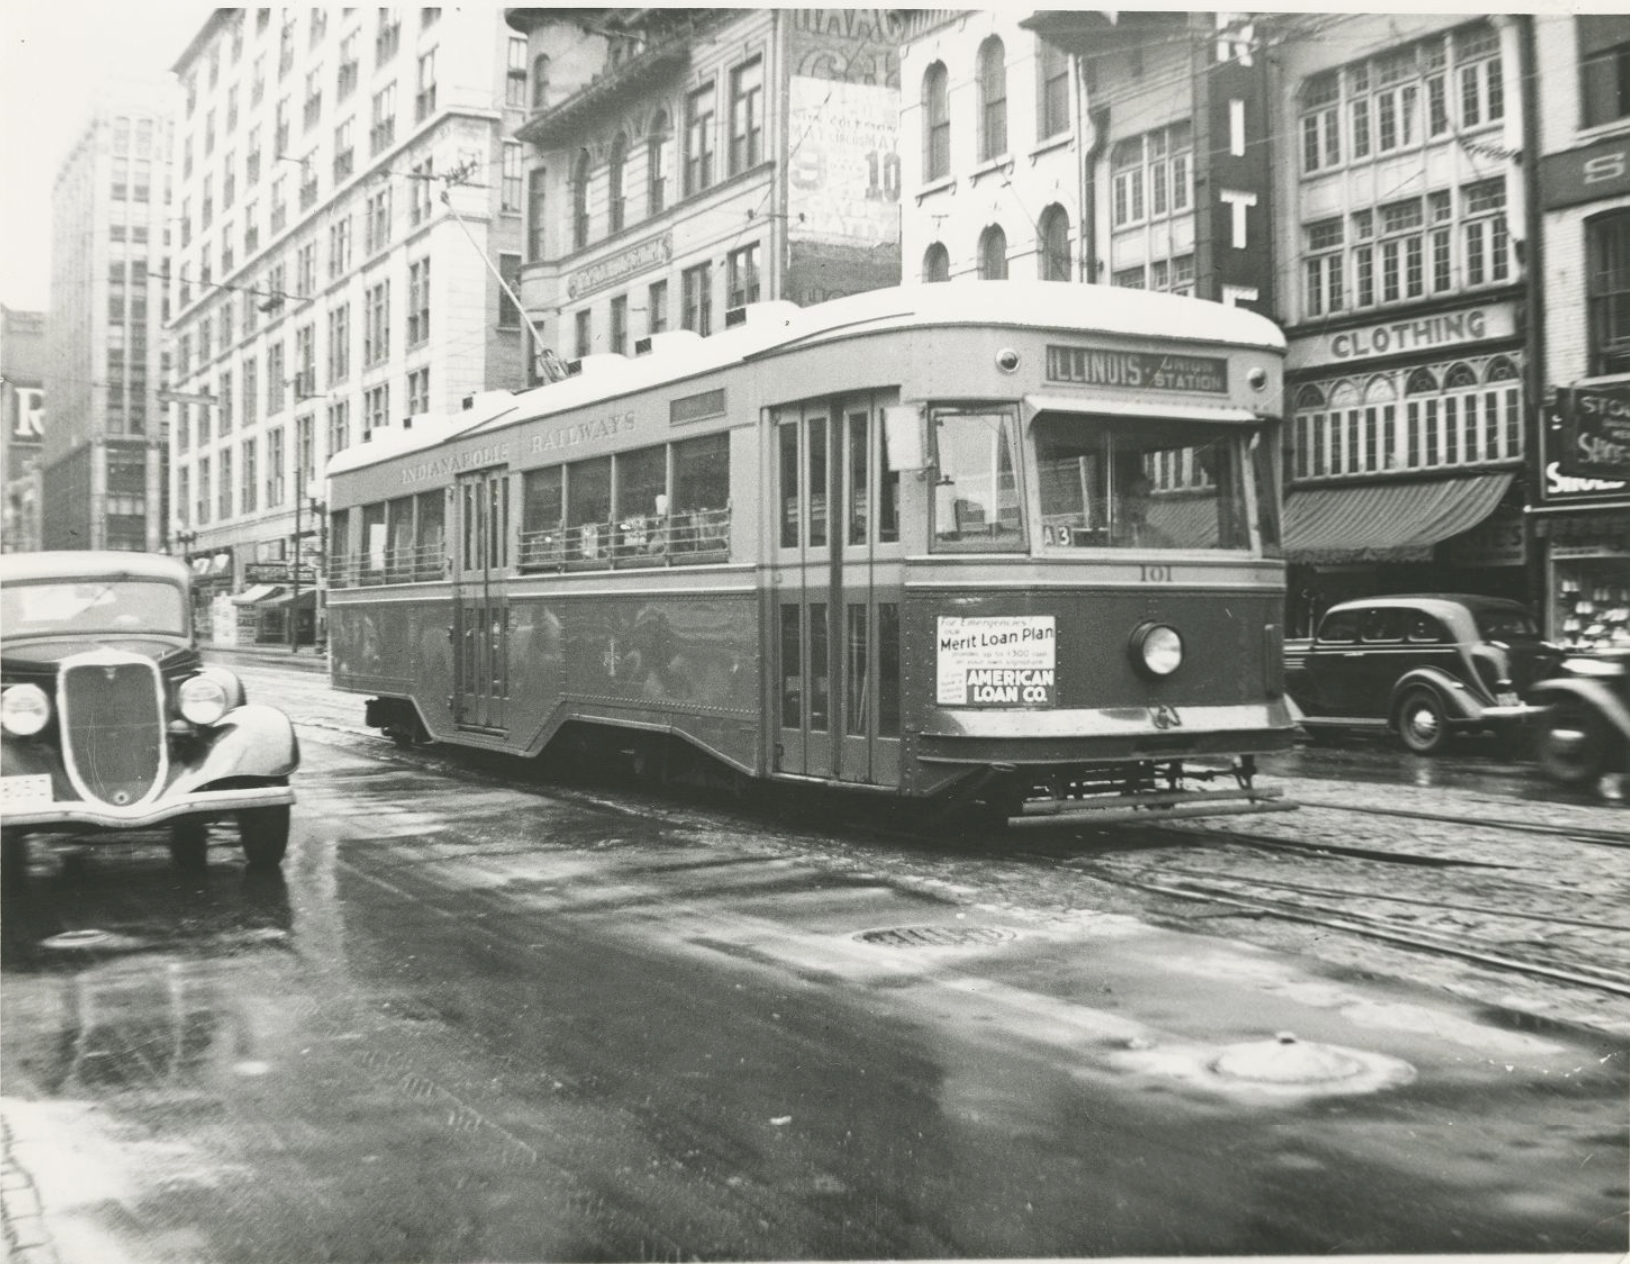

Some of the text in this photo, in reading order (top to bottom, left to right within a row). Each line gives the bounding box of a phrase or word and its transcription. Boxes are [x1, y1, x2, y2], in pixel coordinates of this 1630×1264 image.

[1331, 310, 1487, 359] CLOTHING
[1049, 347, 1142, 386] ILLINOIS
[1154, 372, 1222, 390] STATION
[14, 387, 45, 435] R
[401, 411, 636, 484] INDIANAPOLIS RAILWAYS
[1139, 565, 1173, 583] 101
[940, 626, 1055, 652] Merit Loan Plan
[967, 669, 1054, 686] AMERICAN
[974, 686, 1018, 702] LOAN
